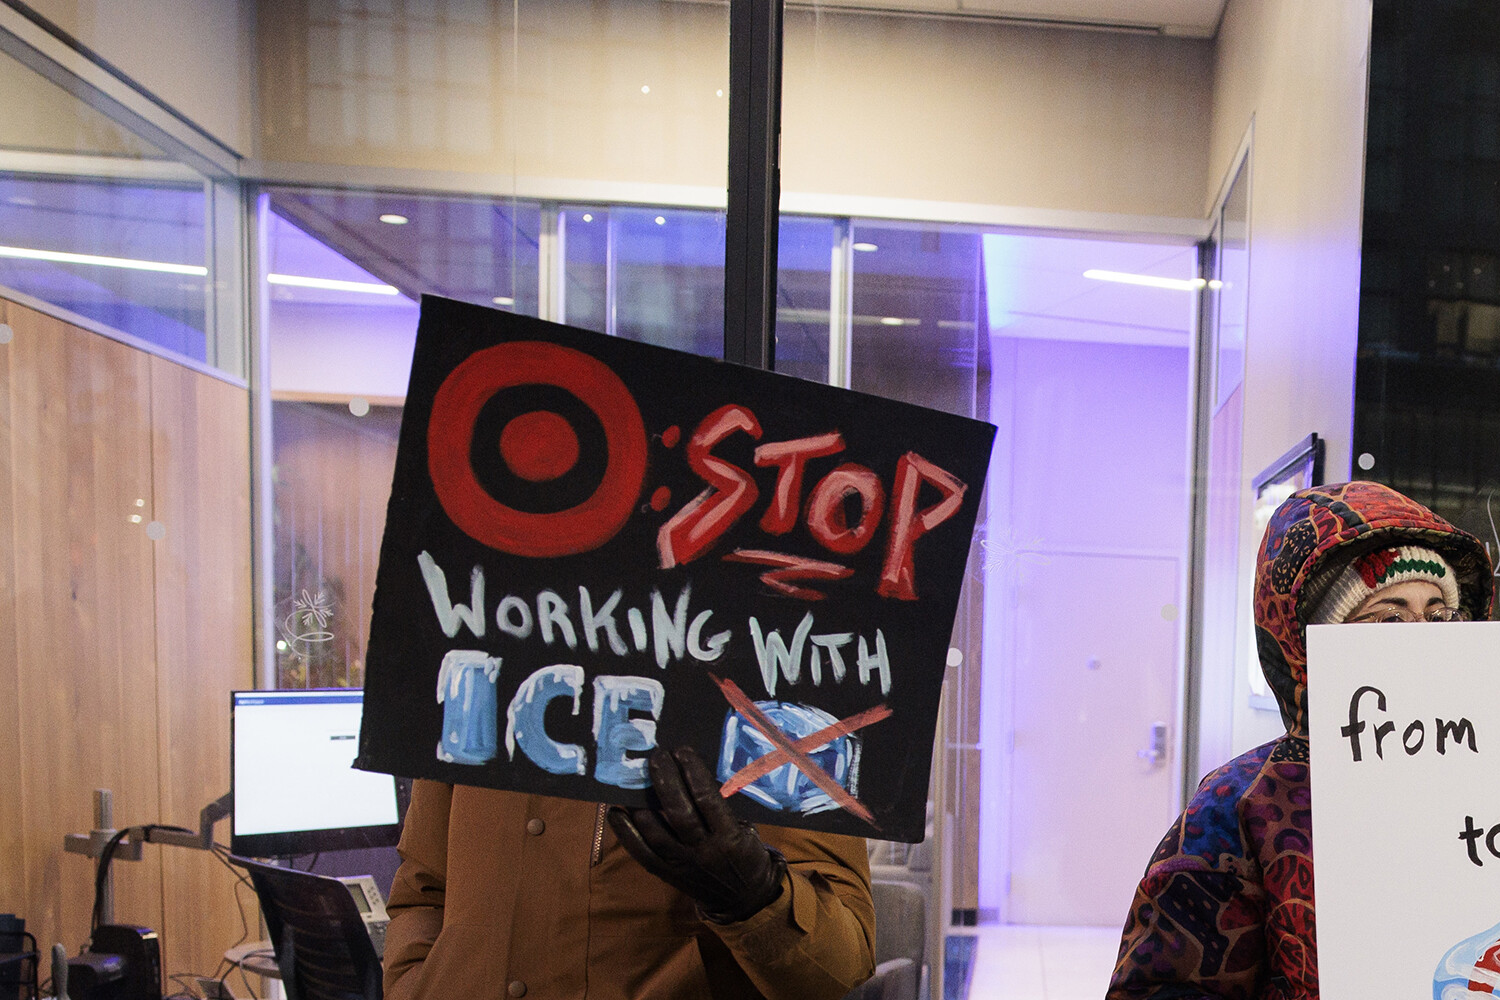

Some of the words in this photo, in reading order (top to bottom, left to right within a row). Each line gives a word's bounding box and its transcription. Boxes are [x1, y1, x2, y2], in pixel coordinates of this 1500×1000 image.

[418, 551, 732, 669] WORKING
[749, 611, 893, 697] WITH
[437, 650, 665, 790] ICE
[1340, 685, 1479, 762] from
